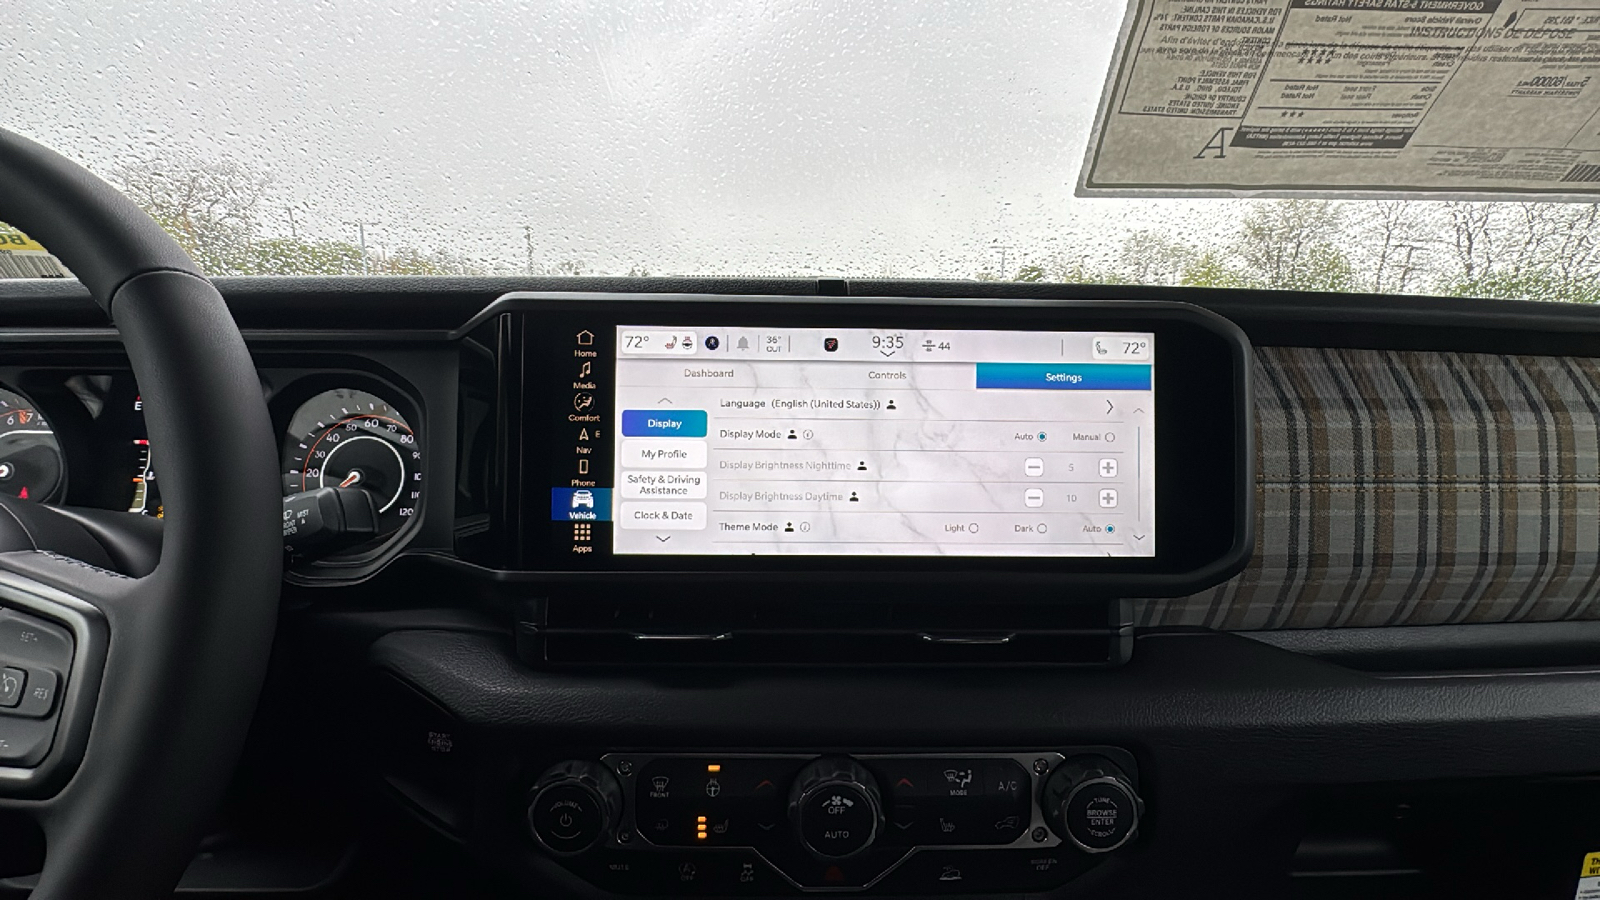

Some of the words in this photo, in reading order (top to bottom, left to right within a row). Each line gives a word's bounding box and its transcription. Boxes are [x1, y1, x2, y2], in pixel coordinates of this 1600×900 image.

[871, 336, 905, 349] 9:35
[937, 341, 951, 351] 44
[574, 350, 597, 358] Home
[684, 368, 734, 378] Dashboard
[868, 371, 907, 380] Controls
[1045, 372, 1083, 383] Settings
[573, 381, 596, 389] Media
[135, 401, 142, 411] E
[720, 399, 766, 410] Language
[771, 399, 809, 410] (English
[810, 399, 844, 410] (United
[845, 399, 881, 410] States))
[7, 415, 14, 425] 6
[26, 412, 33, 422] 7
[568, 414, 600, 422] Comfort
[346, 423, 357, 432] 50
[364, 418, 379, 428] 60
[647, 418, 682, 430] Display
[326, 433, 340, 442] 40
[719, 429, 752, 440] Display
[754, 429, 782, 439] Mode
[1014, 432, 1034, 441] Auto
[1072, 432, 1101, 441] Manual
[400, 435, 414, 444] 80
[314, 450, 326, 458] 30
[576, 446, 592, 454] Nav
[641, 449, 655, 460] My
[658, 449, 687, 459] Profile
[719, 460, 752, 471] Display
[754, 460, 804, 471] Brightness
[805, 460, 851, 471] Nighttime
[1068, 464, 1075, 472] 5
[306, 469, 318, 478] 20
[571, 478, 596, 486] Phone
[627, 474, 655, 486] Safety
[656, 475, 665, 484] &
[667, 474, 700, 486] Driving
[639, 486, 688, 495] Assistance
[719, 491, 752, 502] Display
[754, 491, 804, 502] Brightness
[805, 491, 843, 502] Daytime
[1066, 494, 1077, 503] 10
[400, 508, 414, 516] 120
[569, 511, 597, 520] Vehicle
[634, 510, 662, 520] Clock
[662, 511, 669, 520] &
[670, 511, 693, 520] Date
[719, 522, 750, 532] Theme
[752, 522, 779, 532] Mode
[945, 523, 965, 533] Light
[1014, 524, 1034, 533] Dark
[1082, 524, 1102, 533] Auto
[573, 544, 592, 554] Apps
[998, 781, 1017, 791] A/C
[828, 806, 846, 815] OFF
[1086, 809, 1117, 817] BROWSE
[1091, 818, 1114, 826] ENTER
[824, 830, 850, 839] AUTO
